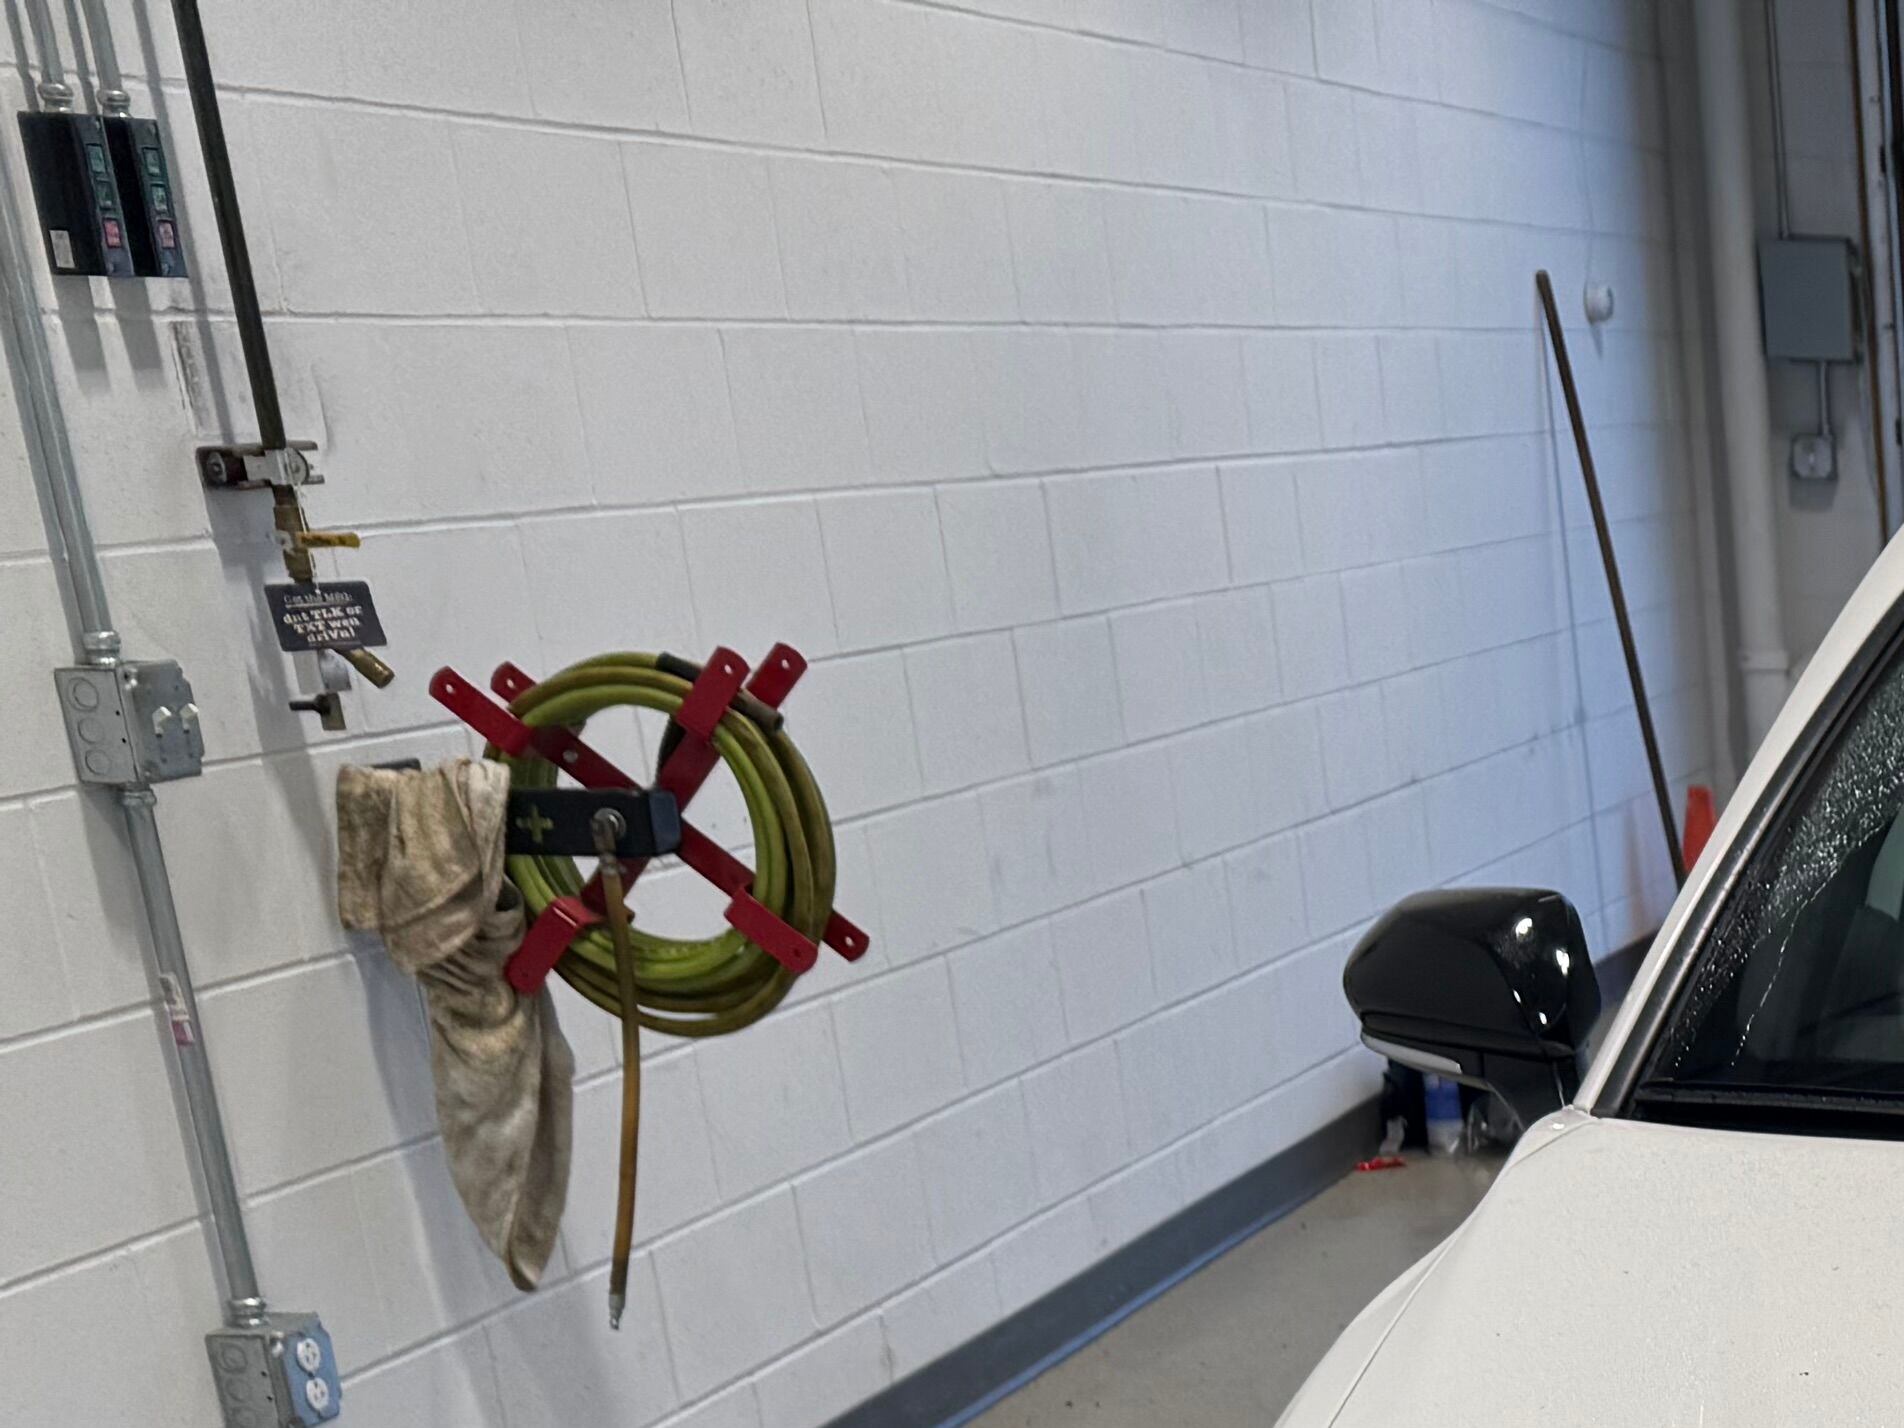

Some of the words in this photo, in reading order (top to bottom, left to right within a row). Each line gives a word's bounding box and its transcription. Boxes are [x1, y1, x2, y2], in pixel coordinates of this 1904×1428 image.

[283, 612, 309, 624] dnt
[310, 606, 345, 618] TLK
[293, 621, 326, 634] TXT
[328, 616, 360, 628] wen
